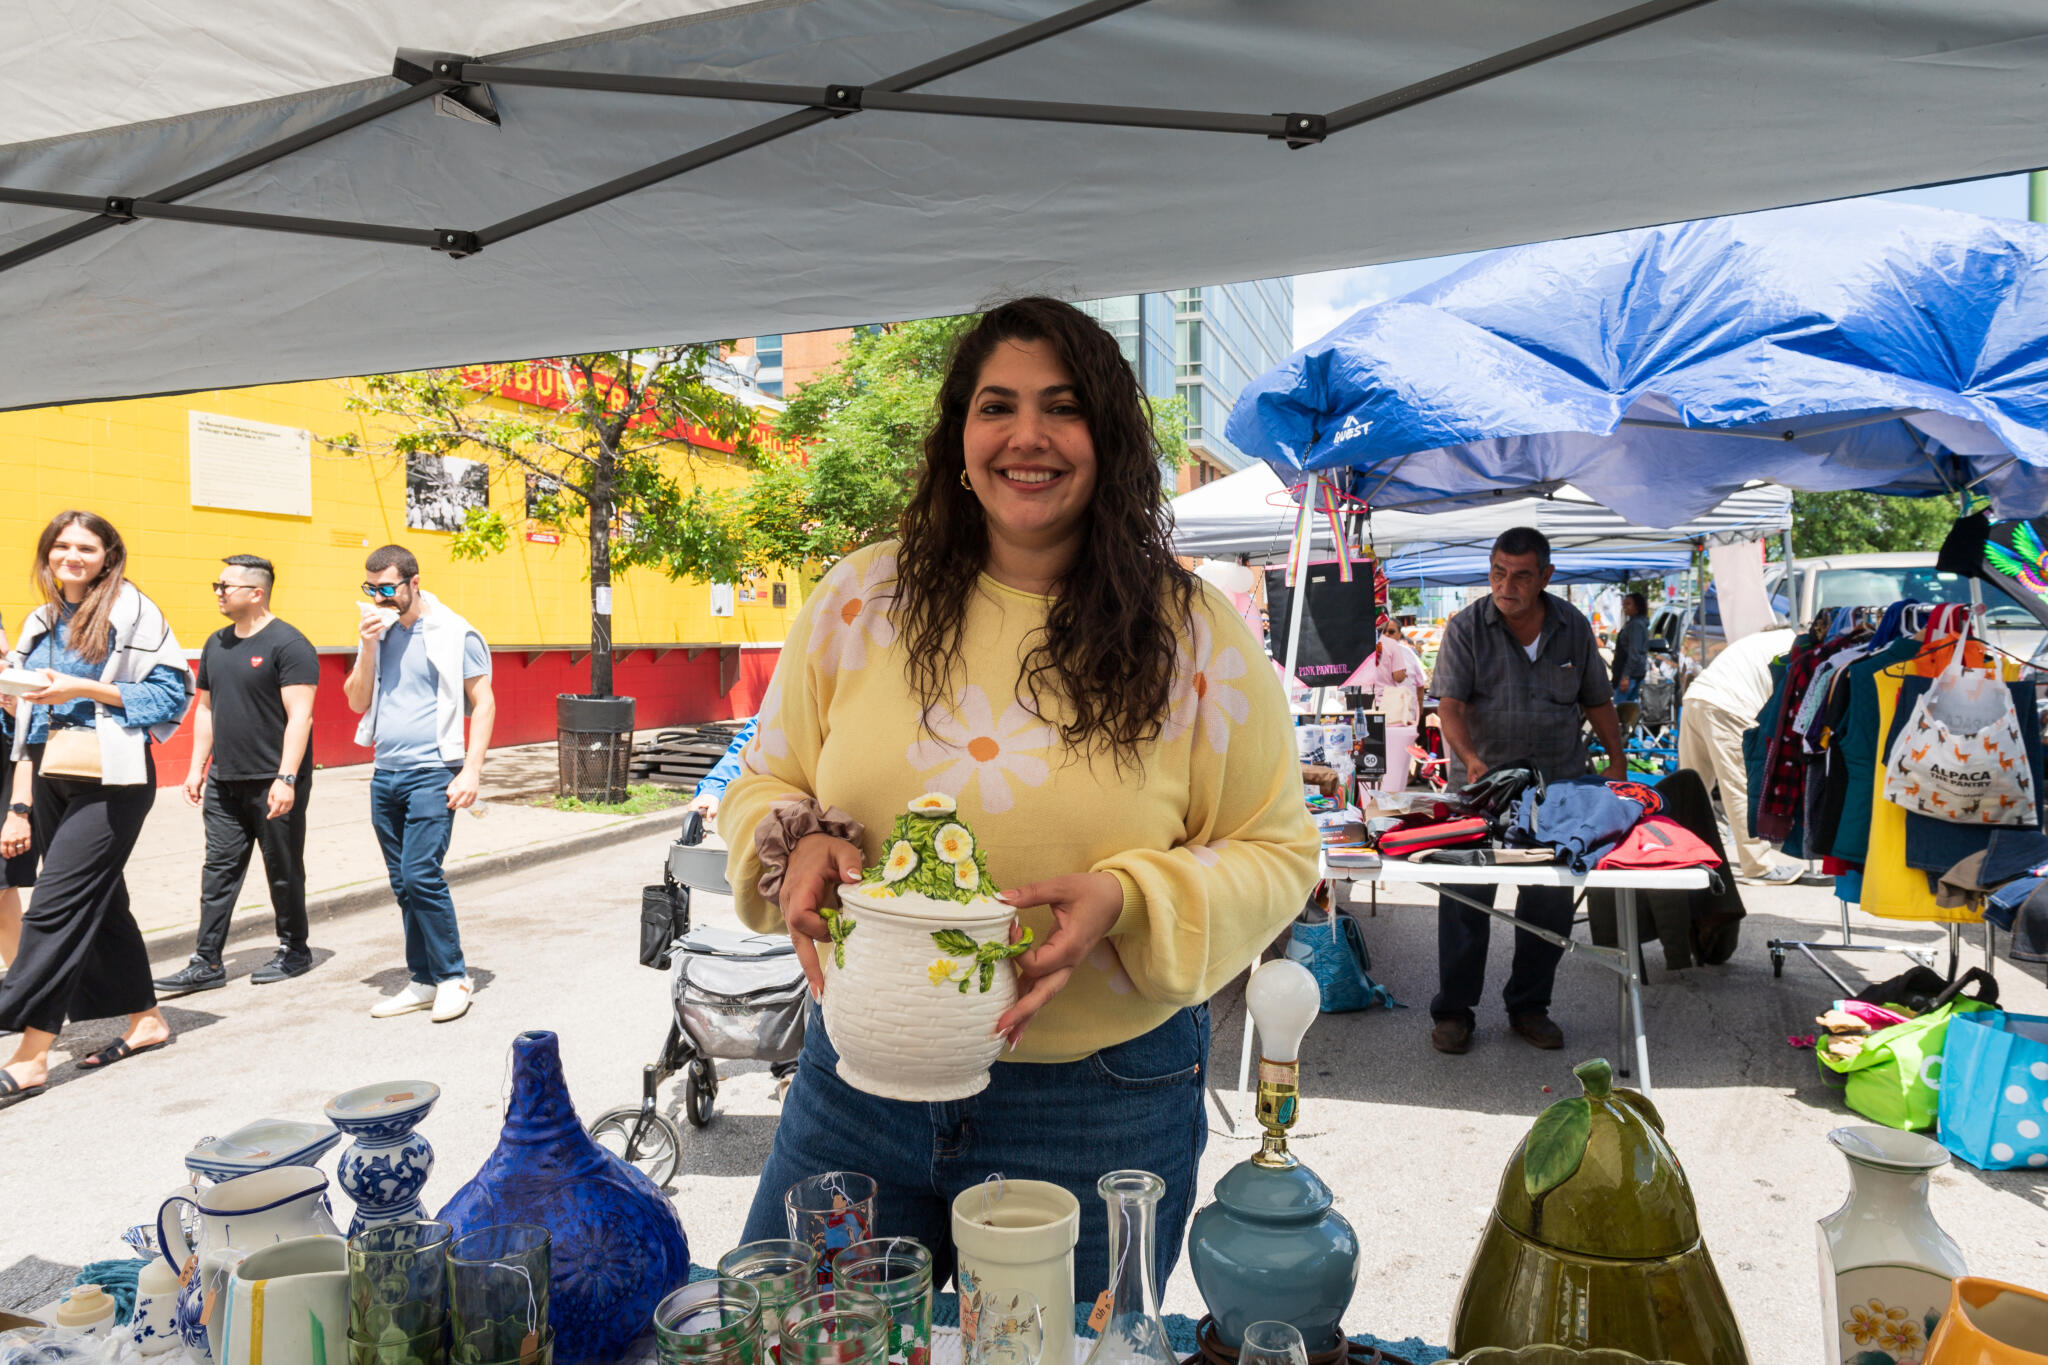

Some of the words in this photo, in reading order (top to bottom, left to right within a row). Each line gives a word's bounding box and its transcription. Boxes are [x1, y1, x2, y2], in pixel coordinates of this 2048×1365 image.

[1298, 666, 1315, 676] PINK
[1315, 664, 1348, 675] PANTHER
[1930, 763, 1991, 781] ALPACA
[1930, 772, 1948, 782] THE
[1950, 780, 1991, 788] PANTRY
